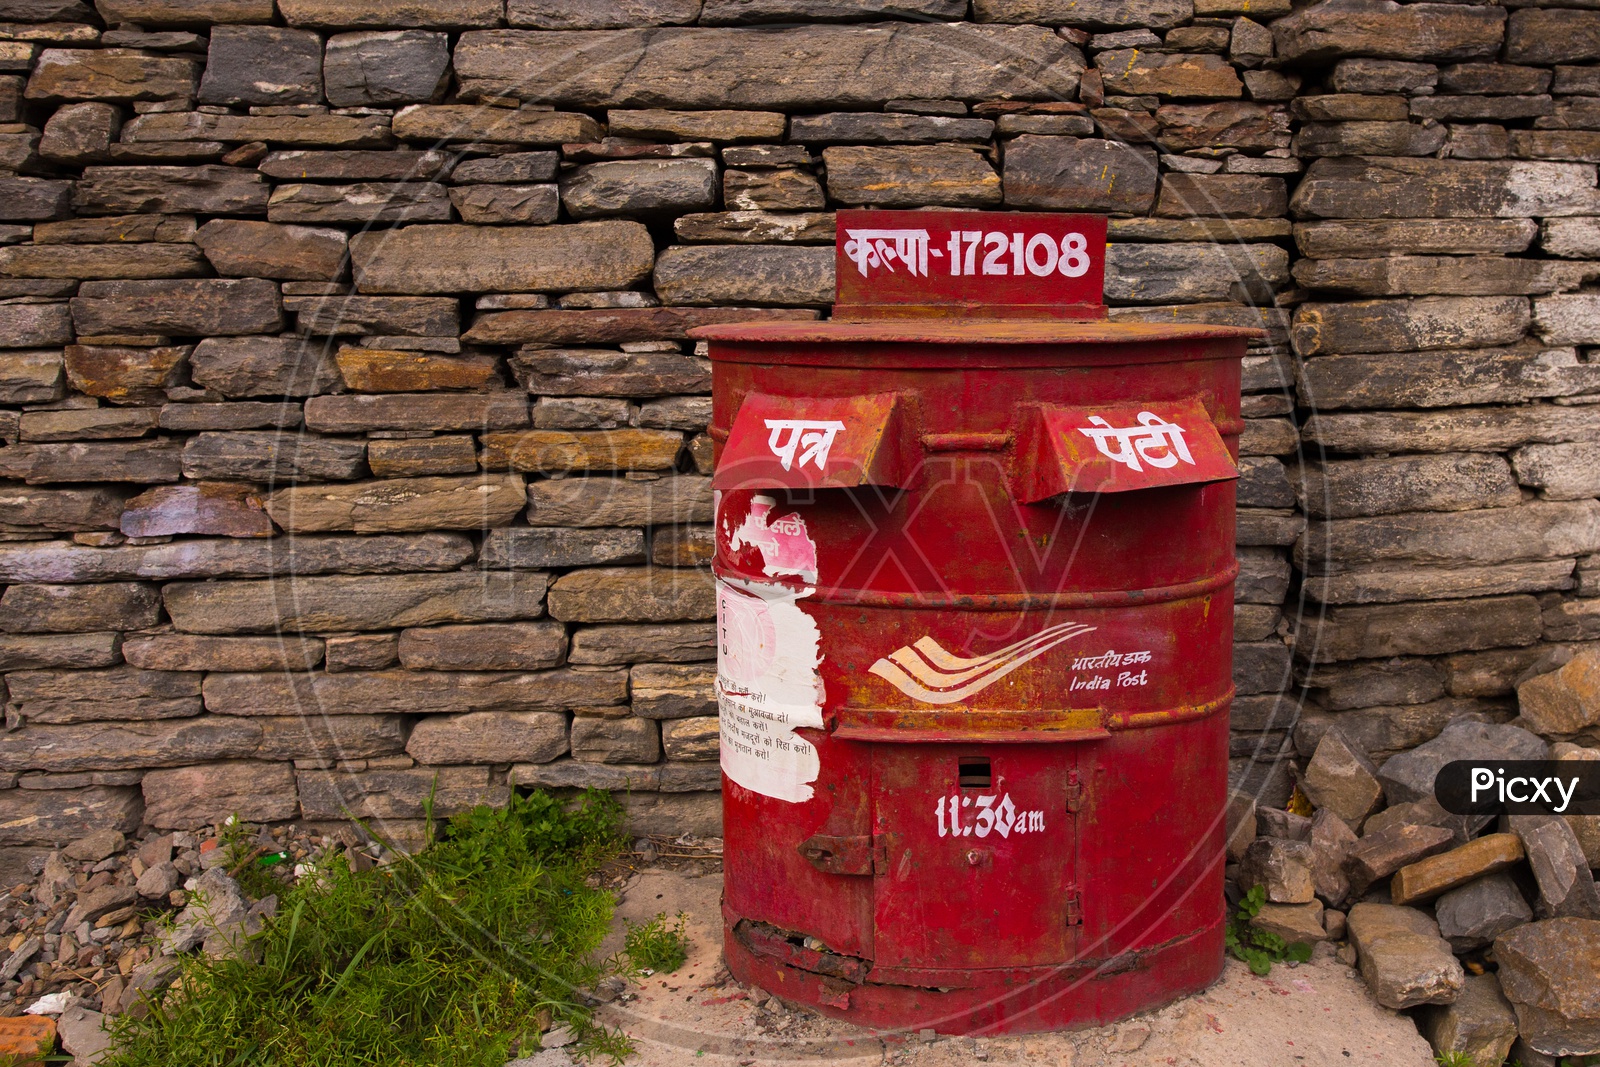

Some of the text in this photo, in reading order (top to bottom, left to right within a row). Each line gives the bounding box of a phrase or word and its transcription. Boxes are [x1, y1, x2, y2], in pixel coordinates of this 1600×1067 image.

[763, 411, 1197, 473] पत्र पेटी
[1071, 649, 1152, 671] भारतीय डाक
[1069, 669, 1148, 692] India Post
[754, 748, 770, 761] करो!
[763, 735, 773, 748] को
[775, 737, 790, 751] रिहा
[793, 742, 811, 756] करो!
